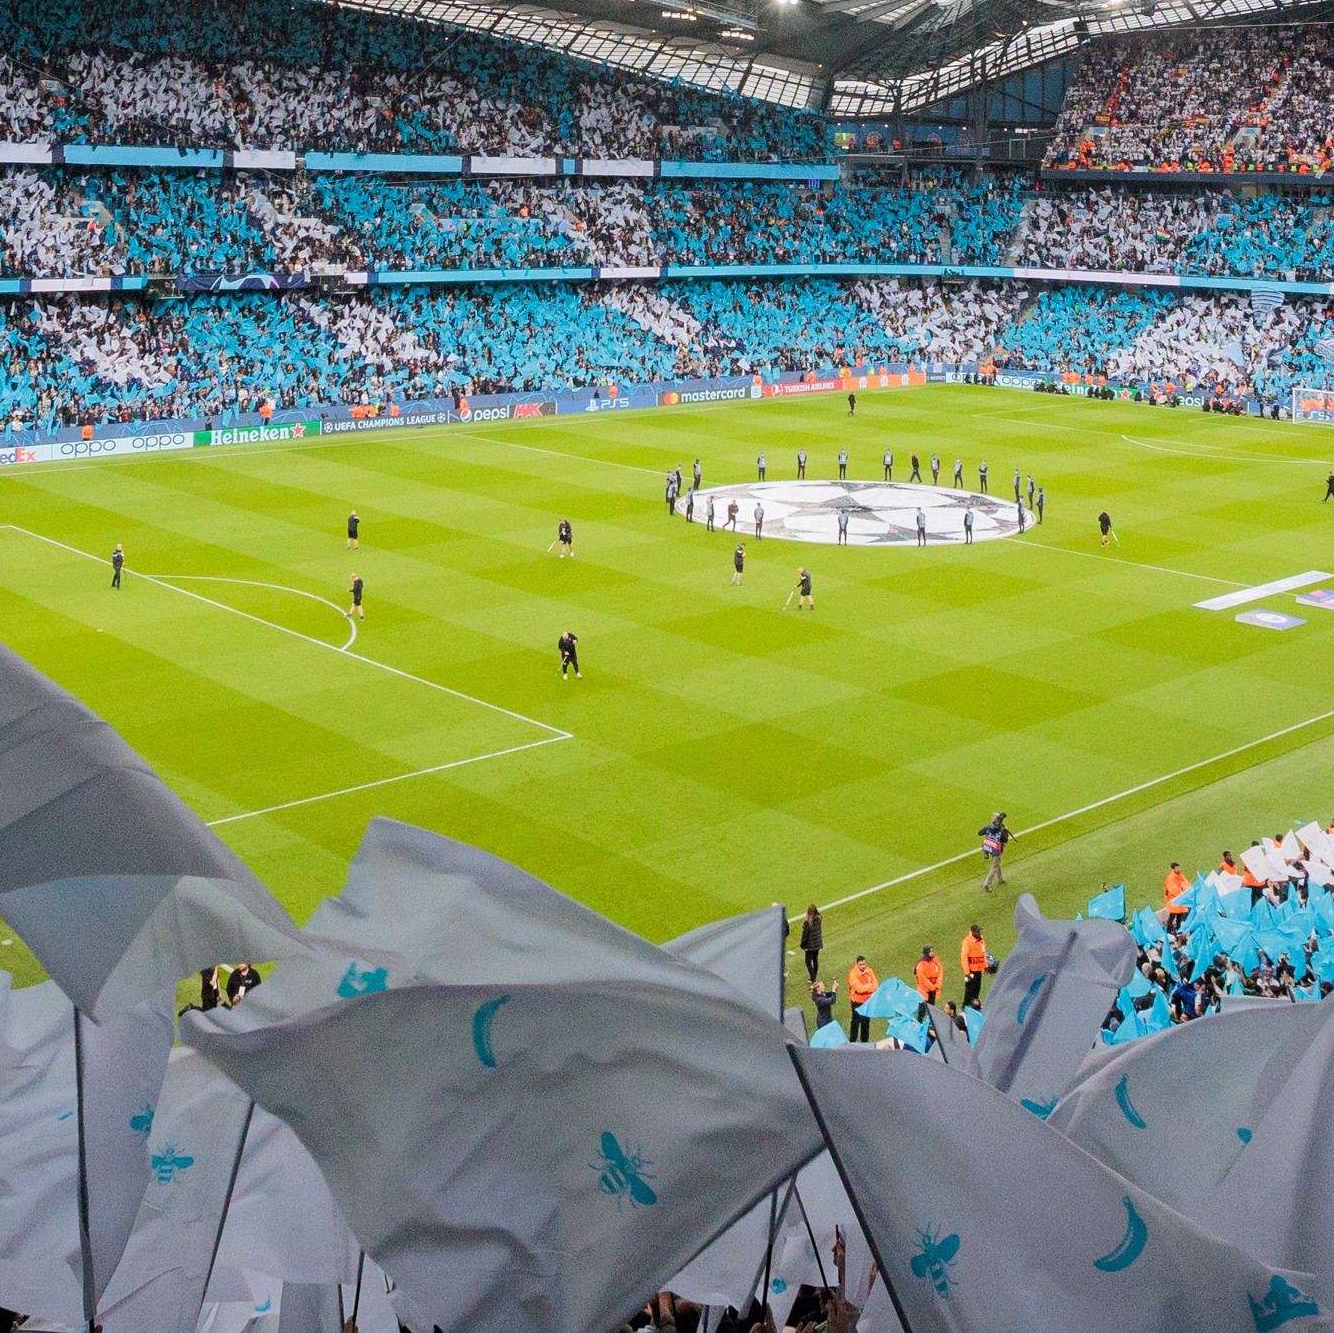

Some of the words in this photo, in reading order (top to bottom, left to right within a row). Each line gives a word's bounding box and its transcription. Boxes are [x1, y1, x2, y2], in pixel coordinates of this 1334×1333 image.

[681, 386, 746, 403] mastercard
[784, 385, 809, 394] TURKISH
[810, 382, 835, 391] AIRLINES
[601, 398, 630, 410] PS5
[474, 405, 510, 423] pepsi
[334, 421, 357, 432] UEFA
[357, 417, 405, 430] CHAMPIONS
[406, 414, 436, 426] LEAGUE
[132, 433, 185, 451] oppo
[210, 422, 290, 446] Heineken
[60, 439, 116, 456] oppo
